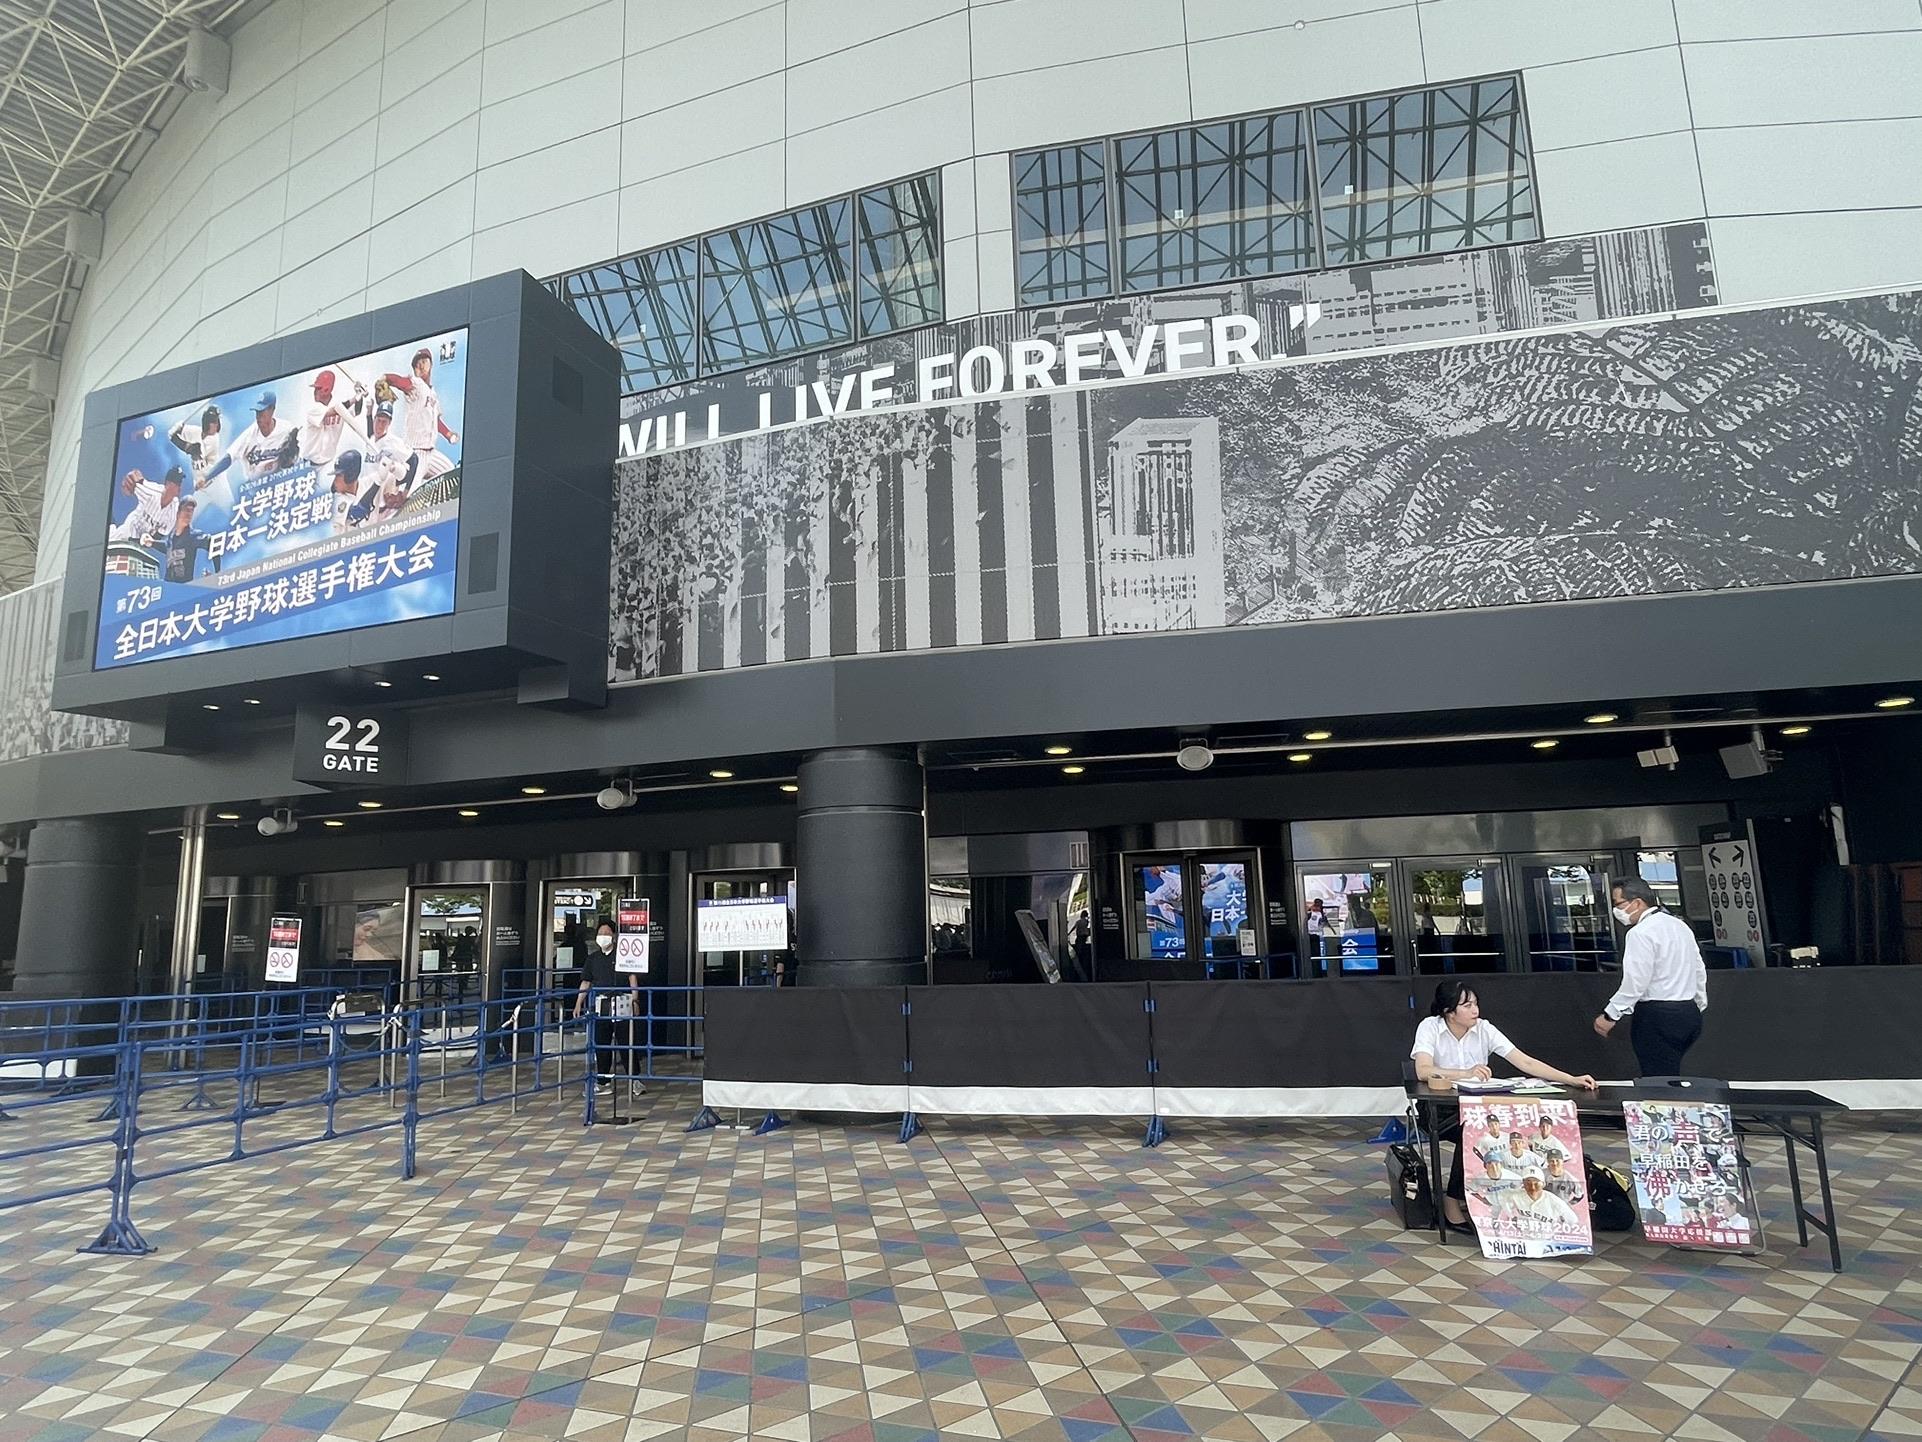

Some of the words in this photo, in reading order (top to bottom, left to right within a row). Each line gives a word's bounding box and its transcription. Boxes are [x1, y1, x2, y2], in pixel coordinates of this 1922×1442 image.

[230, 471, 318, 526] 大学野球
[207, 494, 334, 560] 日本一決定戦
[217, 575, 236, 587] 73rd
[236, 566, 262, 582] Japan
[262, 553, 297, 571] National
[297, 541, 339, 564] Collegiate
[340, 530, 378, 548] Baseball
[378, 509, 442, 537] Championship
[113, 533, 439, 661] 全日本大学野球選手権大会
[115, 586, 163, 614] 第73回
[325, 716, 380, 753] 22
[322, 754, 379, 773] GATE
[1632, 1120, 1724, 1146] 君の声で
[1639, 1152, 1708, 1171] 早稲田を
